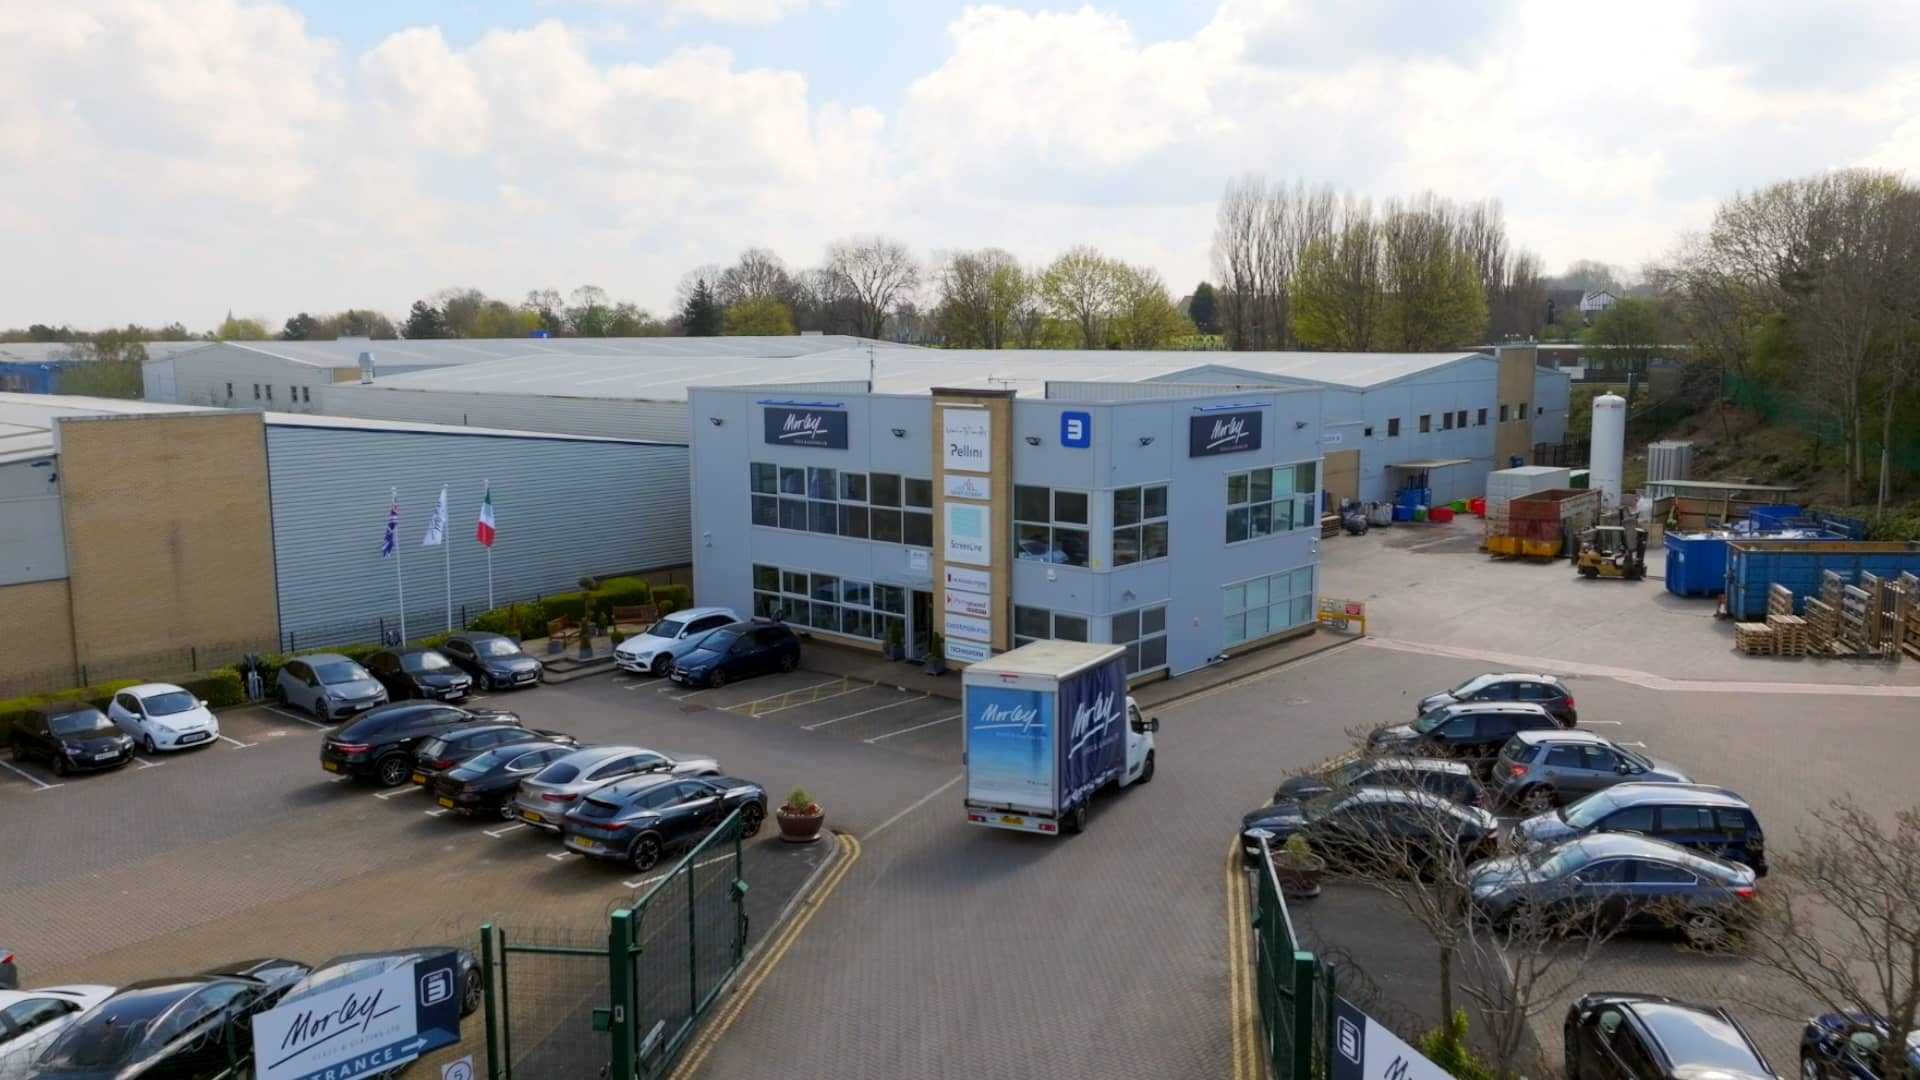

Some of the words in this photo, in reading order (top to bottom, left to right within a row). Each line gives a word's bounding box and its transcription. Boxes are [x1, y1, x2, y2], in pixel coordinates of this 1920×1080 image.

[782, 412, 823, 440] Morley
[1067, 419, 1082, 440] 3
[1210, 416, 1245, 444] Morley
[950, 443, 983, 459] Pellini
[980, 703, 1038, 734] Morley
[1071, 690, 1115, 740] Morley
[428, 978, 446, 1002] 3
[280, 988, 384, 1050] Morley
[304, 1047, 393, 1080] TRANCE
